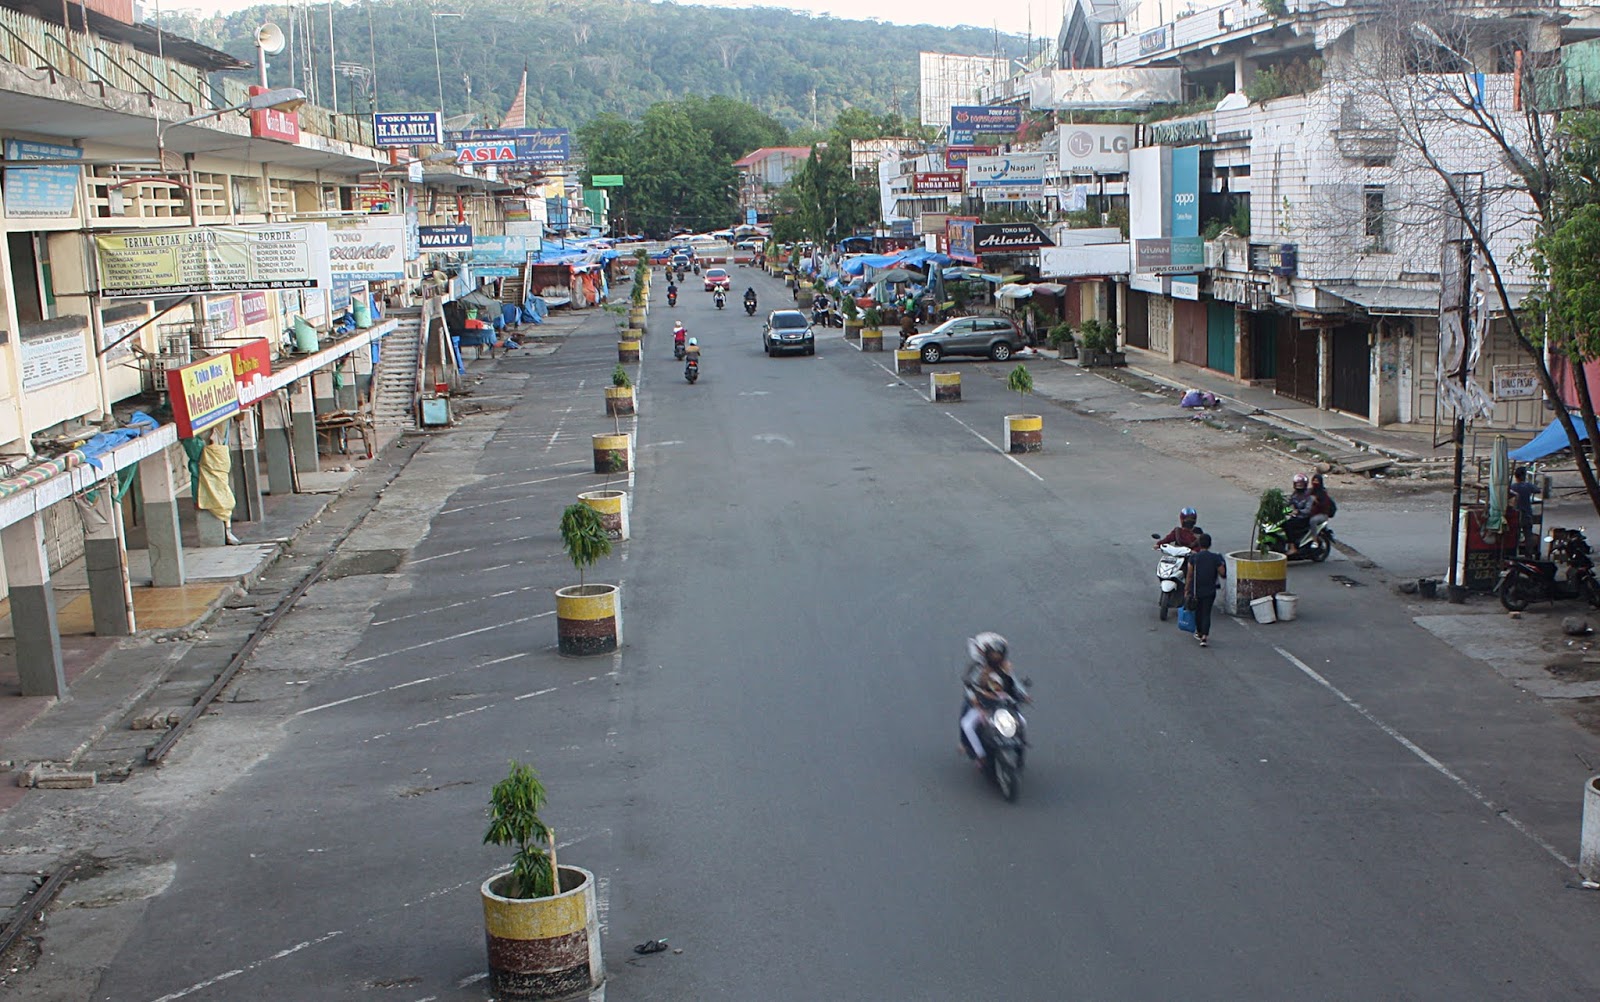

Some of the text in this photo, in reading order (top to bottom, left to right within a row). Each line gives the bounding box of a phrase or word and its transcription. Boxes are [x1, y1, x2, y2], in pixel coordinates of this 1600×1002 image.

[378, 123, 435, 136] H.KAMILI
[532, 131, 562, 150] Jaya
[1100, 136, 1128, 154] LG
[458, 147, 517, 163] ASIA
[1175, 193, 1195, 206] oppo
[124, 237, 154, 248] TERIMA
[155, 235, 180, 246] CETAK
[188, 232, 217, 244] SABLON
[258, 231, 291, 240] BORDIR
[334, 233, 361, 242] TOKO
[421, 234, 468, 245] WAHYU
[979, 234, 1042, 246] Atlantis
[329, 242, 396, 260] exander
[194, 369, 209, 384] Toko
[209, 364, 222, 380] Mas
[188, 386, 214, 416] Melati
[214, 379, 236, 405] Indah
